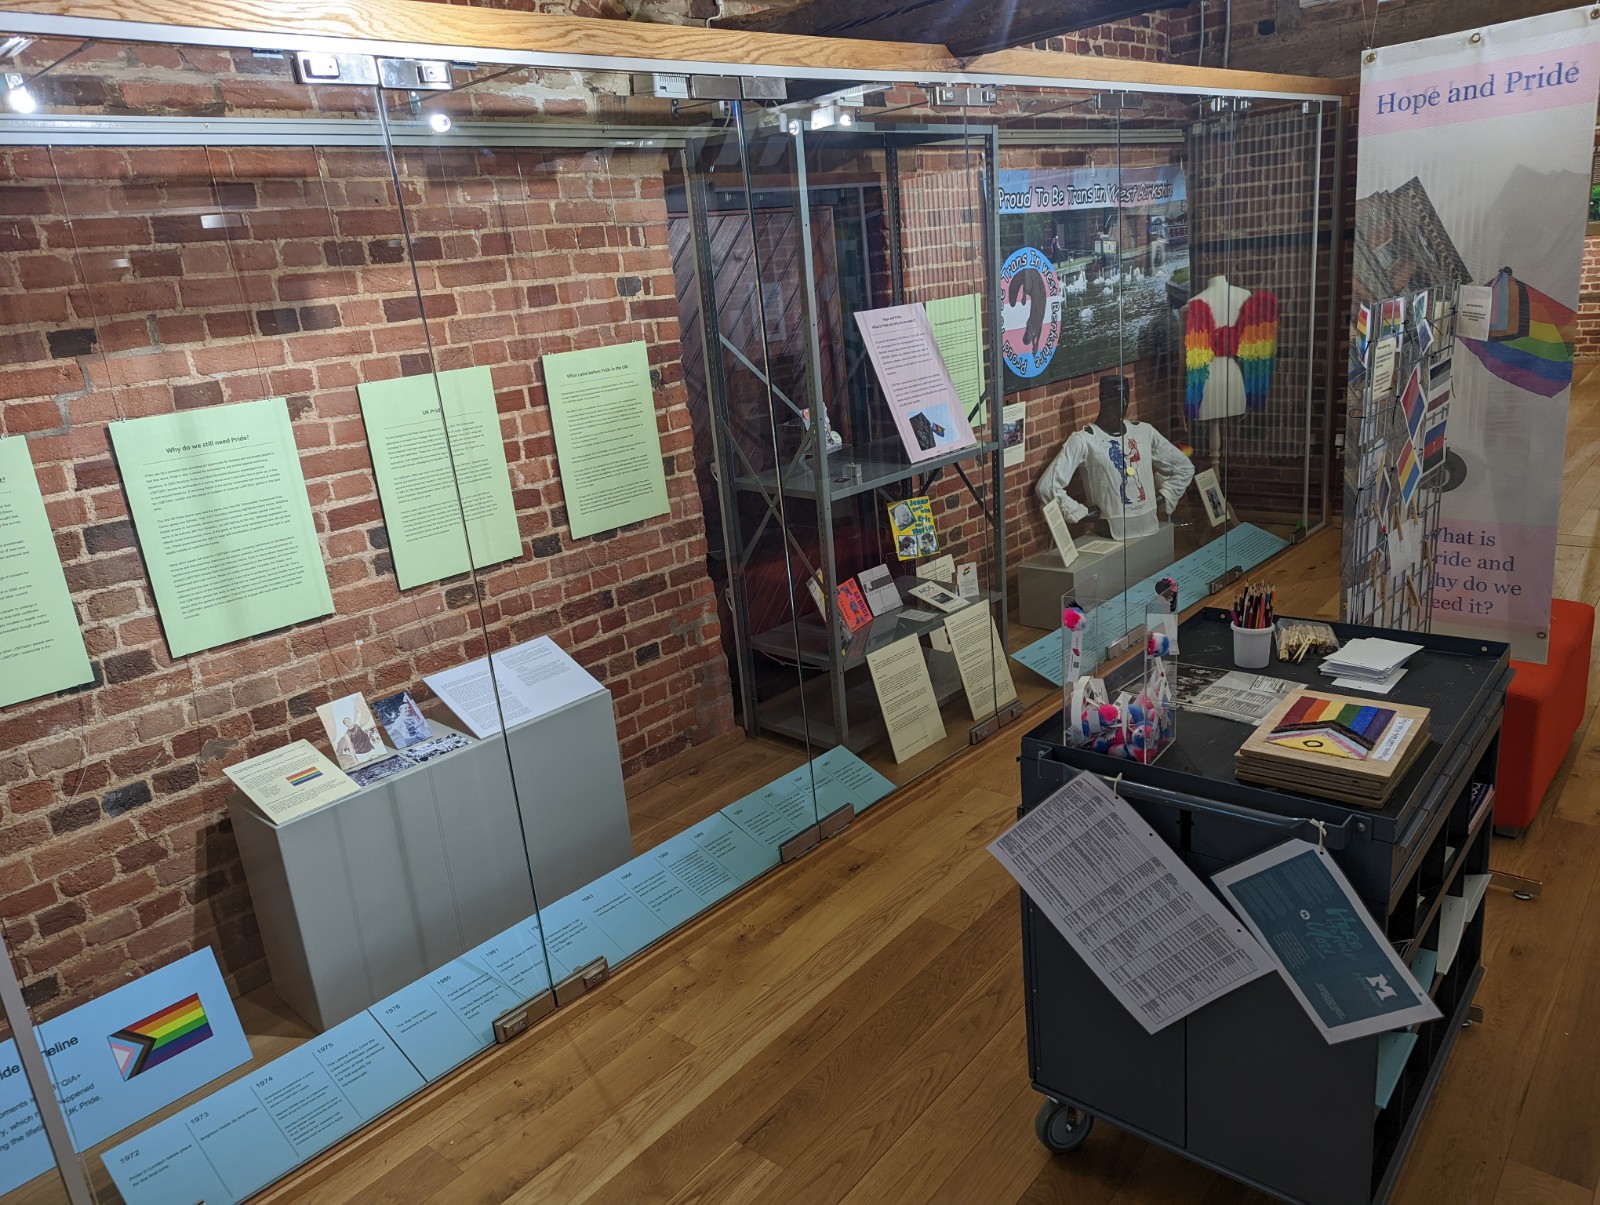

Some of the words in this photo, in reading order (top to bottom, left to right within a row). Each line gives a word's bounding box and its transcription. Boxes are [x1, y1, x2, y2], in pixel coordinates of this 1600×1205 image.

[1376, 91, 1440, 115] Hope
[1448, 74, 1495, 103] and
[1504, 62, 1580, 94] Pride
[999, 186, 1032, 209] Proud
[1036, 188, 1048, 208] To
[1052, 185, 1064, 206] Be
[1068, 184, 1092, 204] Trans
[1094, 184, 1106, 203] In
[1138, 180, 1173, 200] Berkshire
[1001, 254, 1028, 282] Trans
[1030, 251, 1041, 268] In
[1034, 301, 1060, 368] Berkshire
[1003, 340, 1028, 376] Proud
[202, 440, 214, 448] still
[215, 438, 230, 446] need
[231, 434, 250, 442] Pride?
[1480, 530, 1496, 546] is
[1434, 551, 1471, 568] ride
[1477, 556, 1516, 572] and
[1463, 576, 1488, 592] do
[1494, 582, 1522, 596] we
[853, 592, 869, 618] GEORGE
[1469, 598, 1493, 615] it?
[384, 1004, 401, 1016] 1976
[317, 1042, 334, 1055] 1975
[256, 1076, 273, 1088] 1974
[80, 1095, 102, 1110] Pride.
[10, 1115, 34, 1130] which
[190, 1111, 210, 1125] 1973
[120, 1149, 141, 1164] 1972
